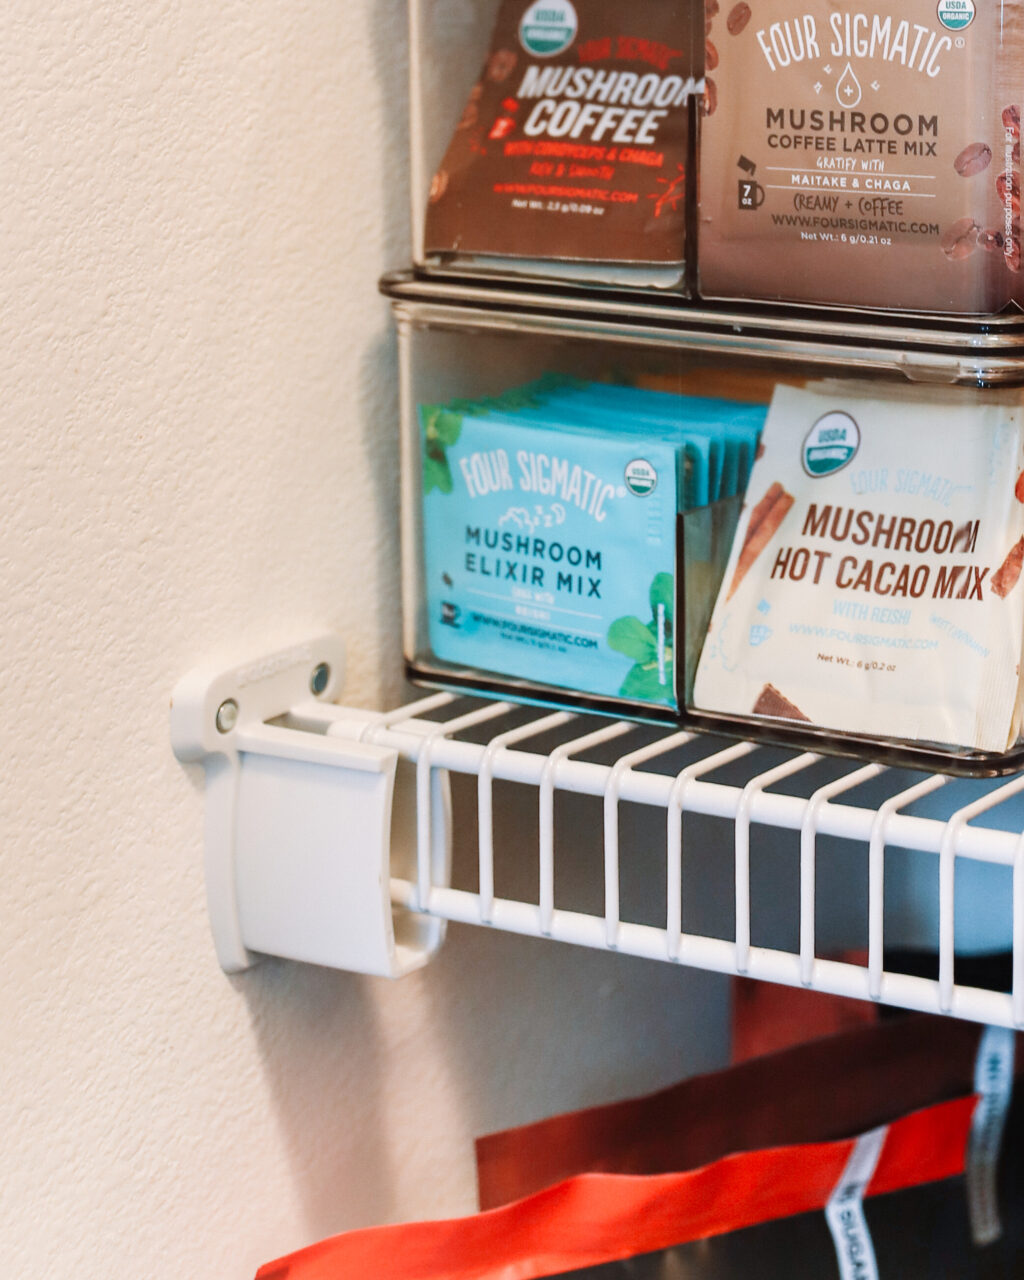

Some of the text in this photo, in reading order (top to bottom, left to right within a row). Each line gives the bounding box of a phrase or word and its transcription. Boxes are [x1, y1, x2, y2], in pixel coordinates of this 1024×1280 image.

[942, 12, 970, 20] ORGANIC
[945, 1, 967, 10] USDA
[756, 12, 952, 78] FOUR SIGMATIC
[523, 99, 668, 144] COFFEE
[766, 108, 938, 137] MUSHROOM
[767, 134, 937, 157] COFFEE LATTE MIX
[816, 156, 885, 173] GRATIFY WITH
[743, 184, 752, 197] 7
[791, 174, 911, 192] MAITAKE & CHAGA
[793, 193, 839, 213] CREAMY
[1003, 192, 1013, 236] purposes
[771, 213, 940, 236] WWW.FOURSIGMATIC.COM
[801, 231, 817, 242] Net
[841, 233, 848, 243] 6
[880, 237, 892, 246] oz
[459, 448, 513, 499] FOUR
[517, 449, 615, 522] SIGMATIC
[801, 503, 981, 554] MUSHROOM
[465, 525, 602, 571] MUSHROOM
[465, 552, 545, 588] ELIXIR
[557, 571, 602, 599] MIX
[770, 546, 990, 601] HOT CACAO MIX
[832, 599, 869, 621] WITH
[816, 652, 834, 664] Net
